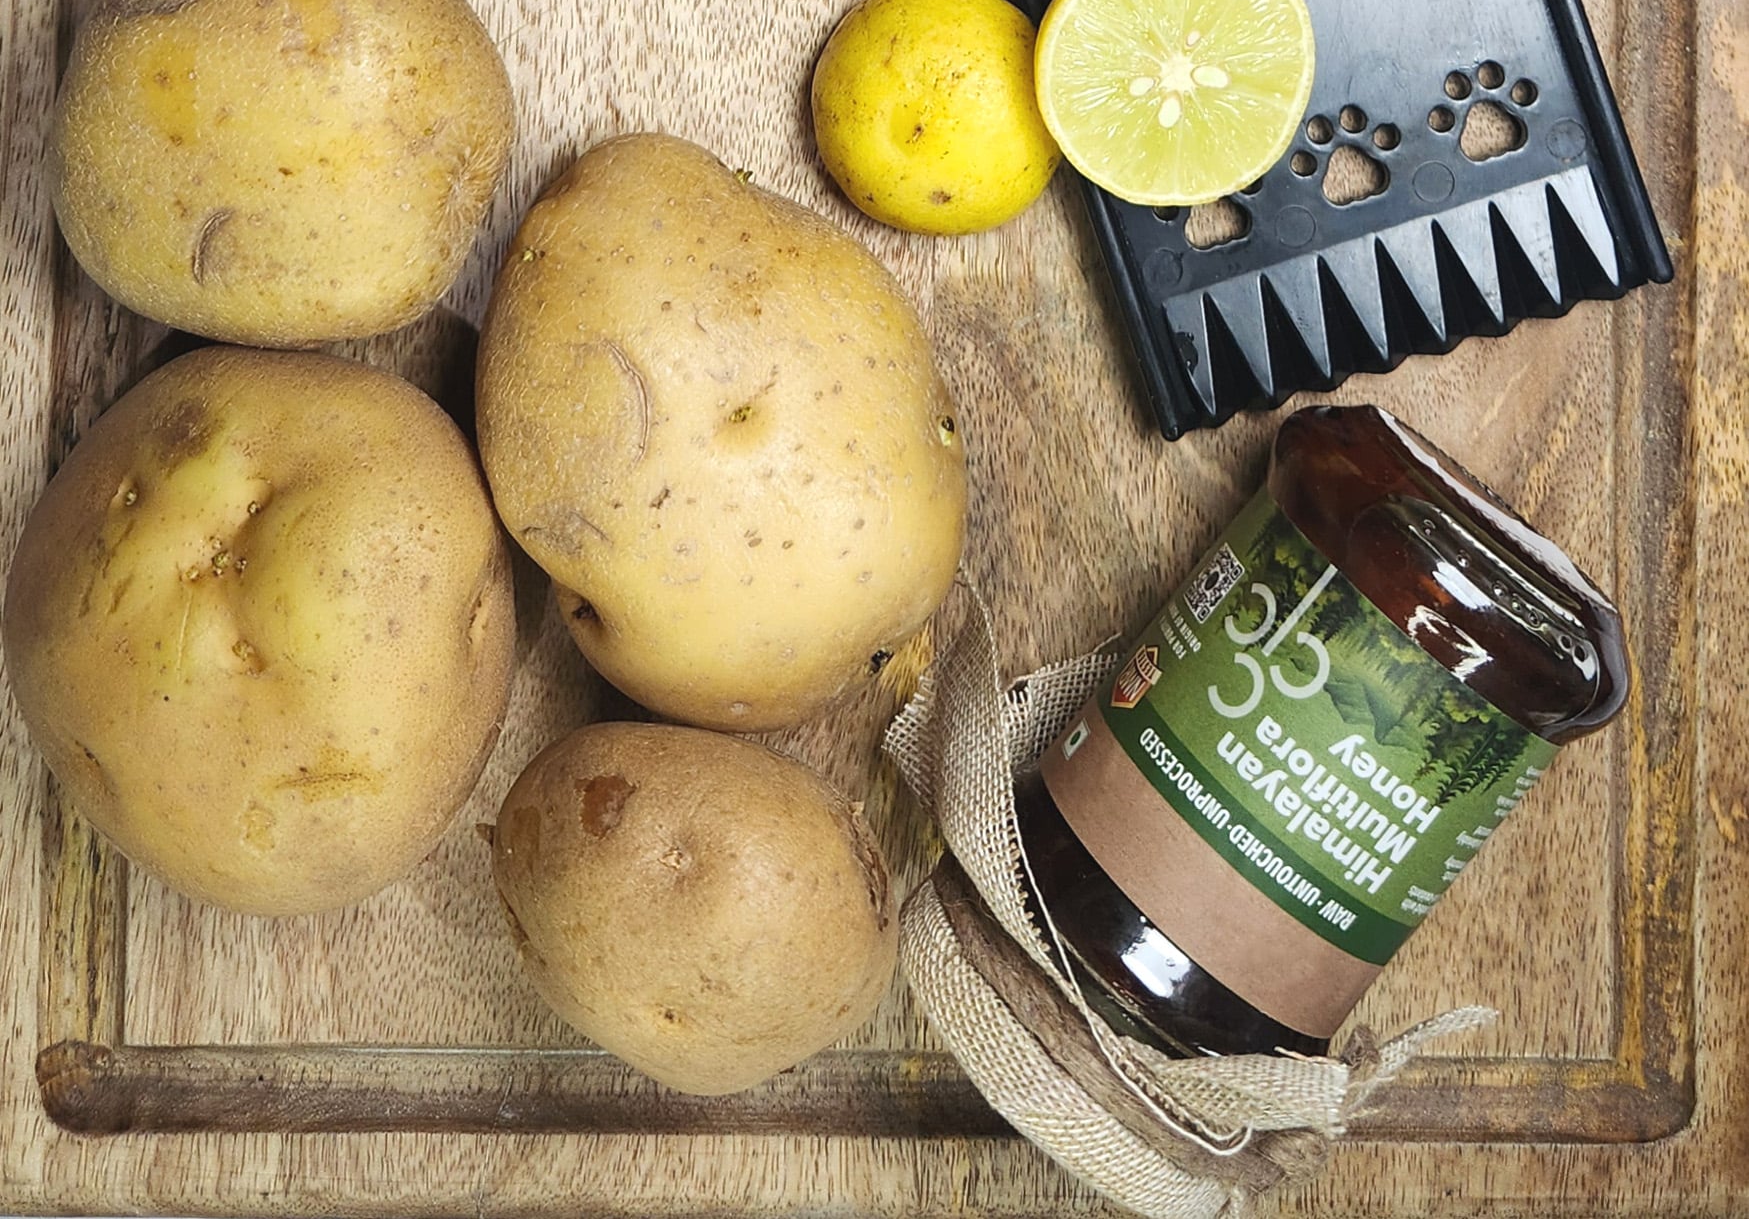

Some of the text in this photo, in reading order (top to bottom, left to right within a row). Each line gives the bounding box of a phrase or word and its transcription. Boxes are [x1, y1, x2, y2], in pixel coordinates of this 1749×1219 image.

[1172, 640, 1187, 660] FOR
[1179, 623, 1202, 653] ORIGIN
[1216, 731, 1393, 895] Himalayan
[1256, 715, 1417, 864] Multiflora
[1328, 734, 1441, 834] Honey
